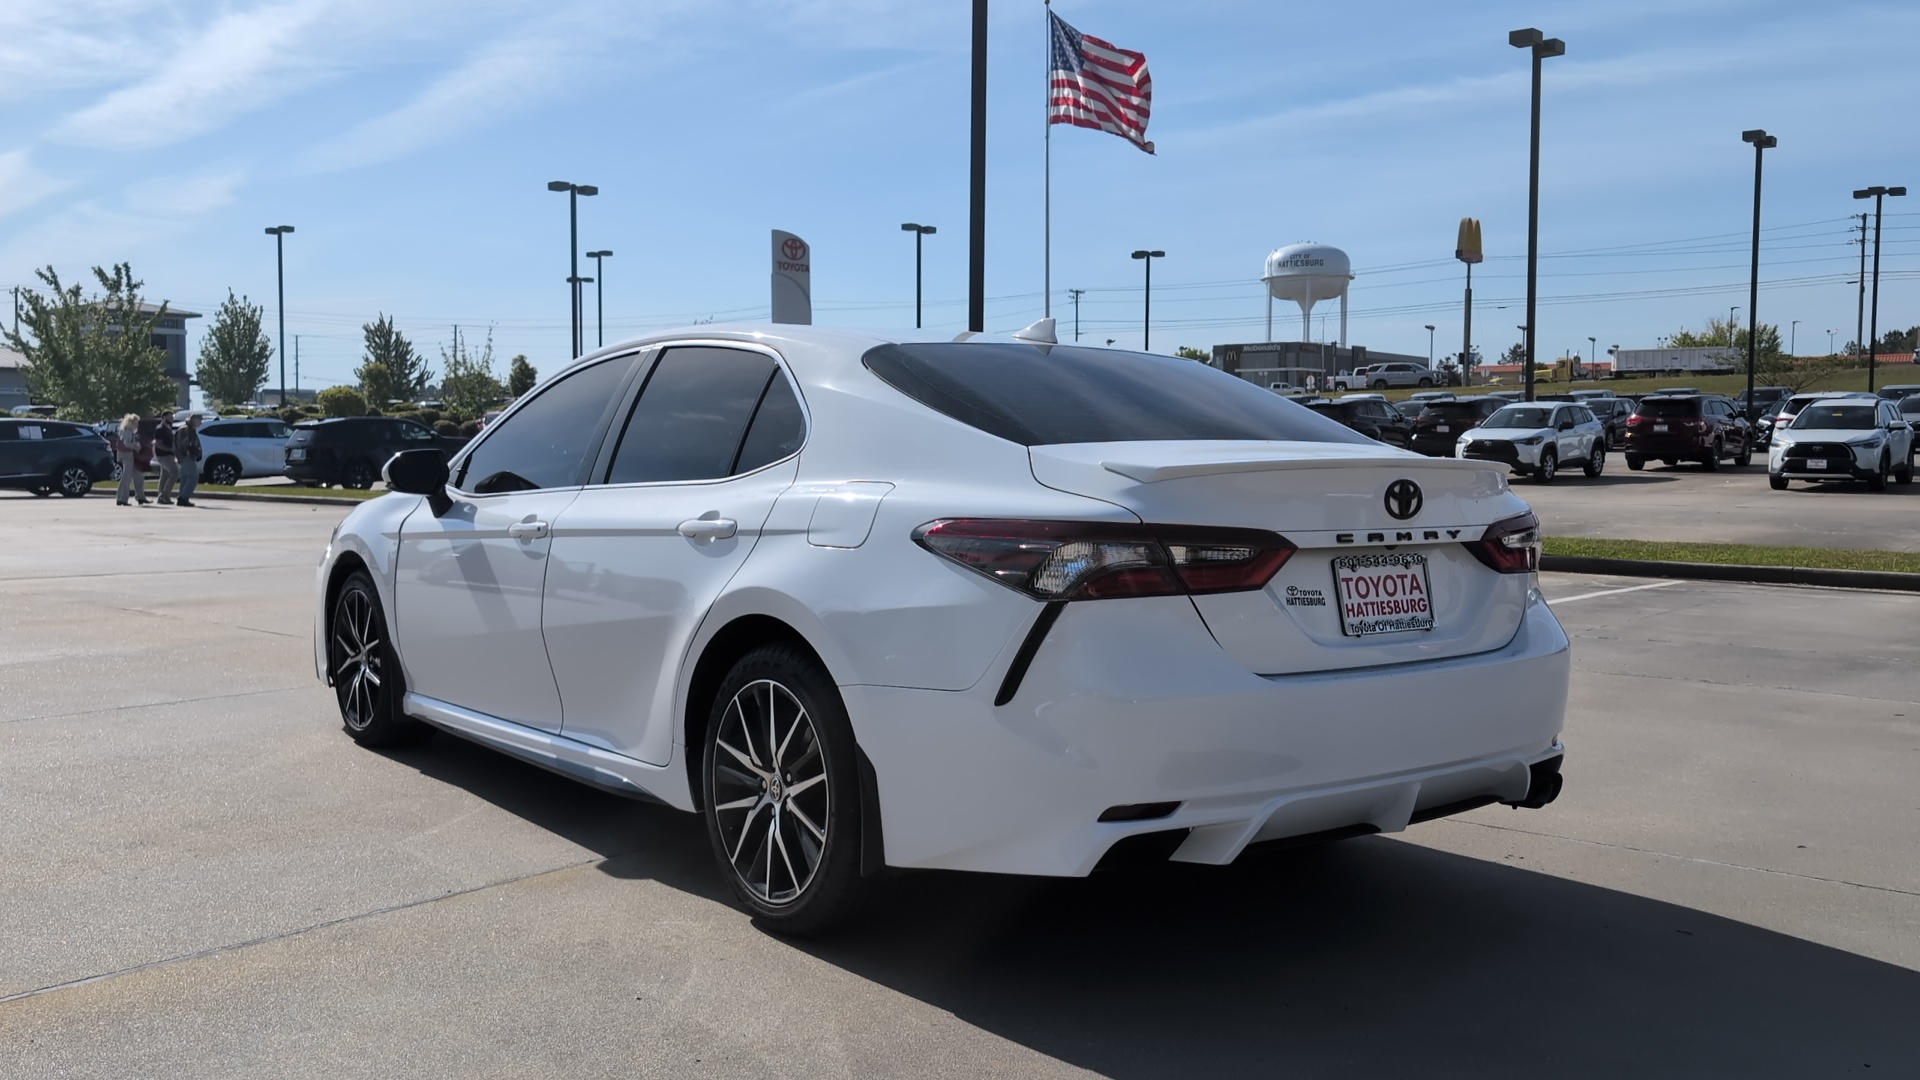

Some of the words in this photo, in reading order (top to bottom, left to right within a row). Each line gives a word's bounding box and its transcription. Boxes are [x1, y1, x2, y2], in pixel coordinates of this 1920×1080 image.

[777, 261, 810, 272] TOYOTA
[1278, 259, 1324, 268] HATTIESBURG
[1243, 344, 1281, 352] McDonald's
[1336, 530, 1461, 543] CAMRY
[1339, 554, 1424, 568] 601-544-9630
[1341, 573, 1423, 599] TOYOTA
[1299, 589, 1322, 597] TOYOTA
[1286, 597, 1326, 607] HATTIESBURG
[1345, 598, 1428, 618] HATTIESBURG
[1350, 622, 1376, 634] Toyota
[1378, 620, 1388, 632] Of
[1389, 618, 1434, 630] Hattiesburg
